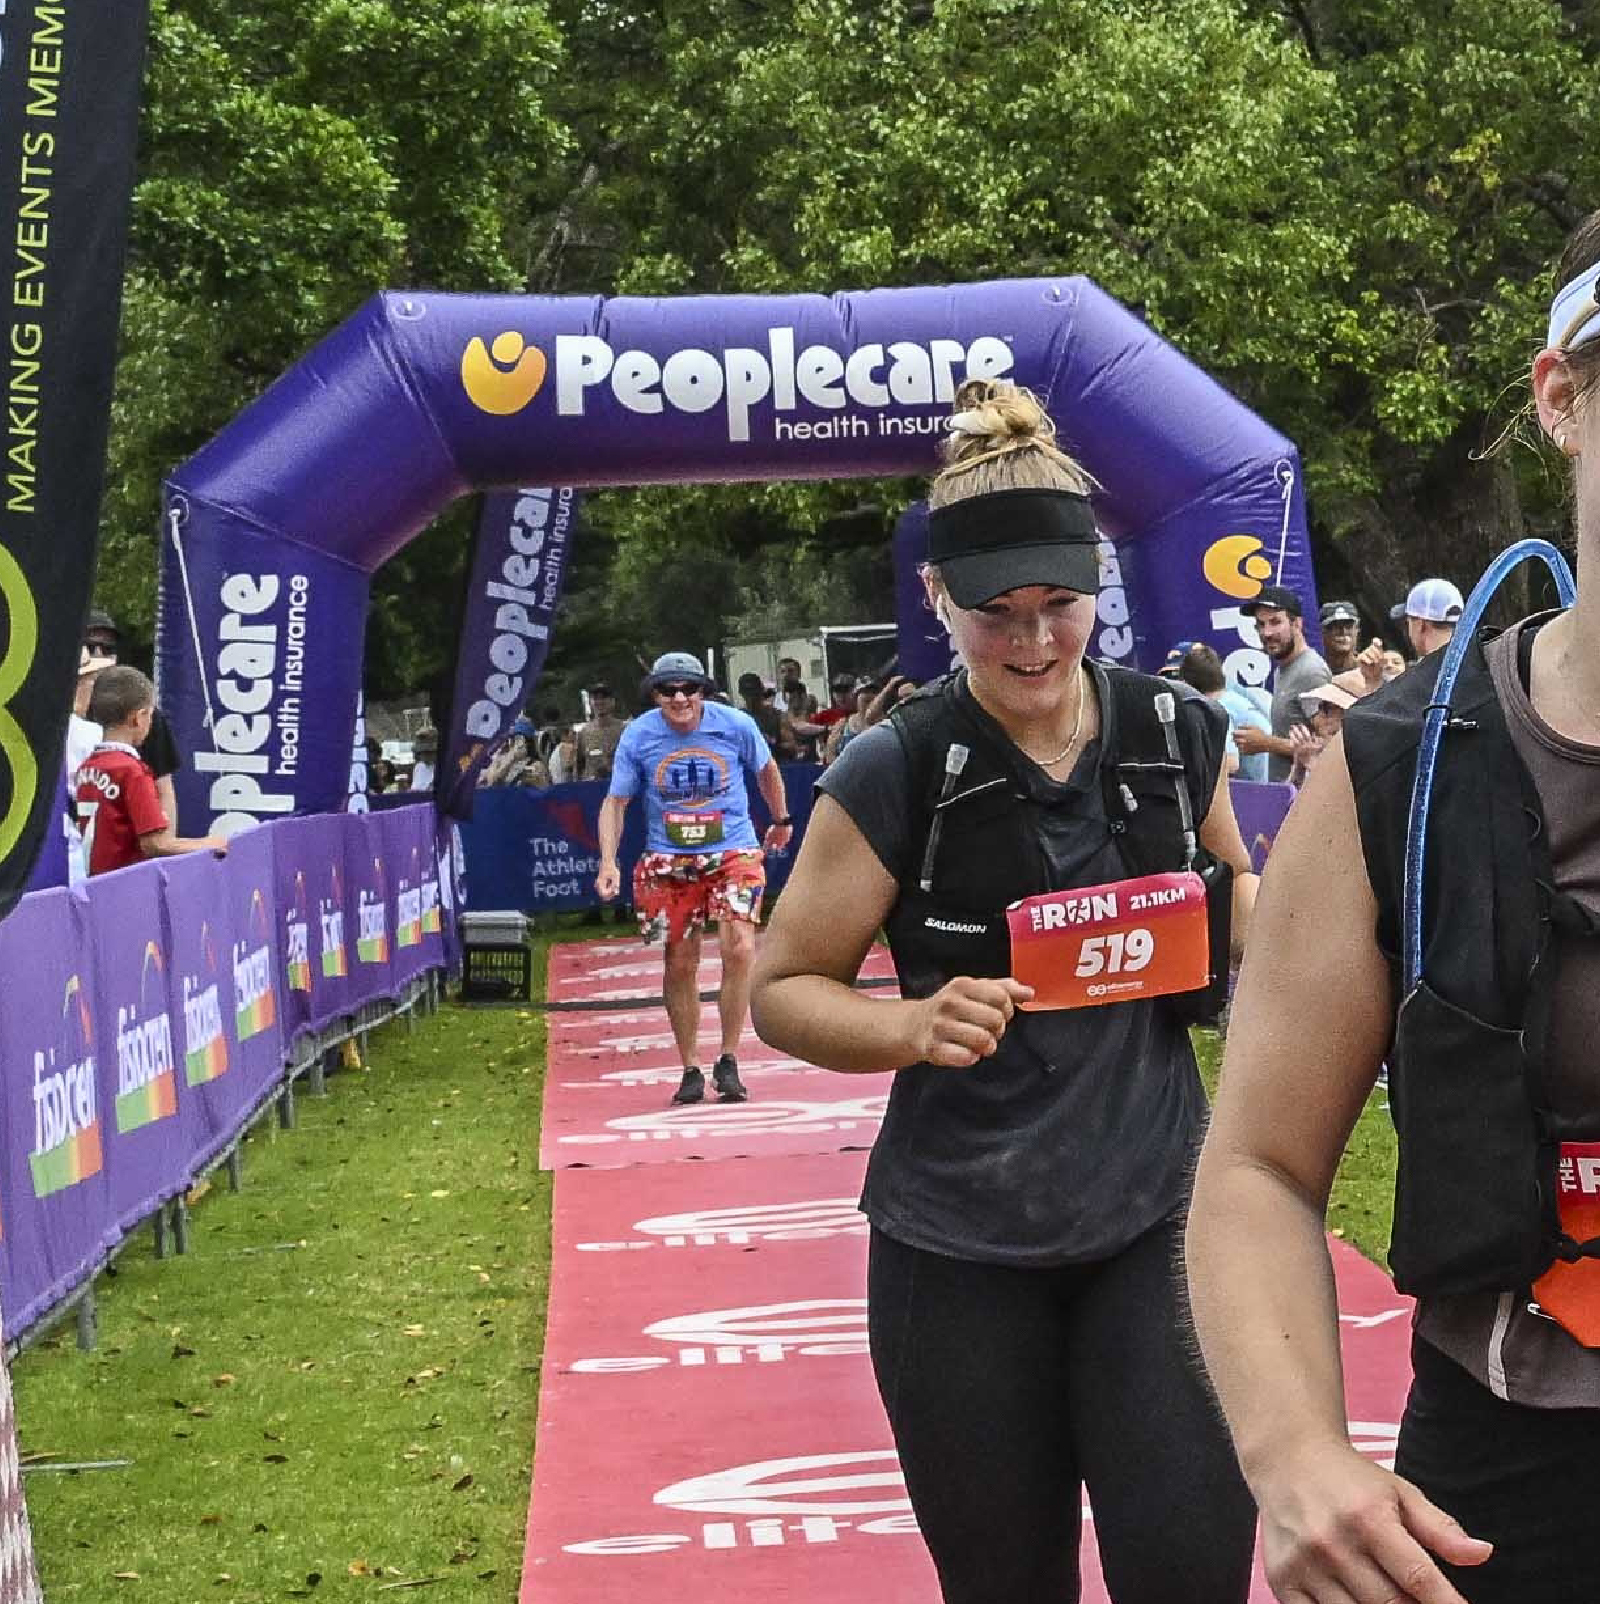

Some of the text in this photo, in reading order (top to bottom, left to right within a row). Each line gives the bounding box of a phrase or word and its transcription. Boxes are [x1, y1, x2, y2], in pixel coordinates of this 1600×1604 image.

[6, 0, 67, 513] MAKING EVENTS MEM
[555, 326, 1015, 442] Peoplecare
[775, 415, 868, 440] health
[275, 574, 310, 775] health insurance
[530, 837, 569, 857] The
[532, 879, 582, 898] Foot
[1041, 891, 1119, 930] RUN
[1129, 886, 1186, 910] 21.1KM
[924, 917, 988, 934] SALOMON
[1075, 928, 1155, 978] 519
[1560, 1156, 1580, 1193] THE
